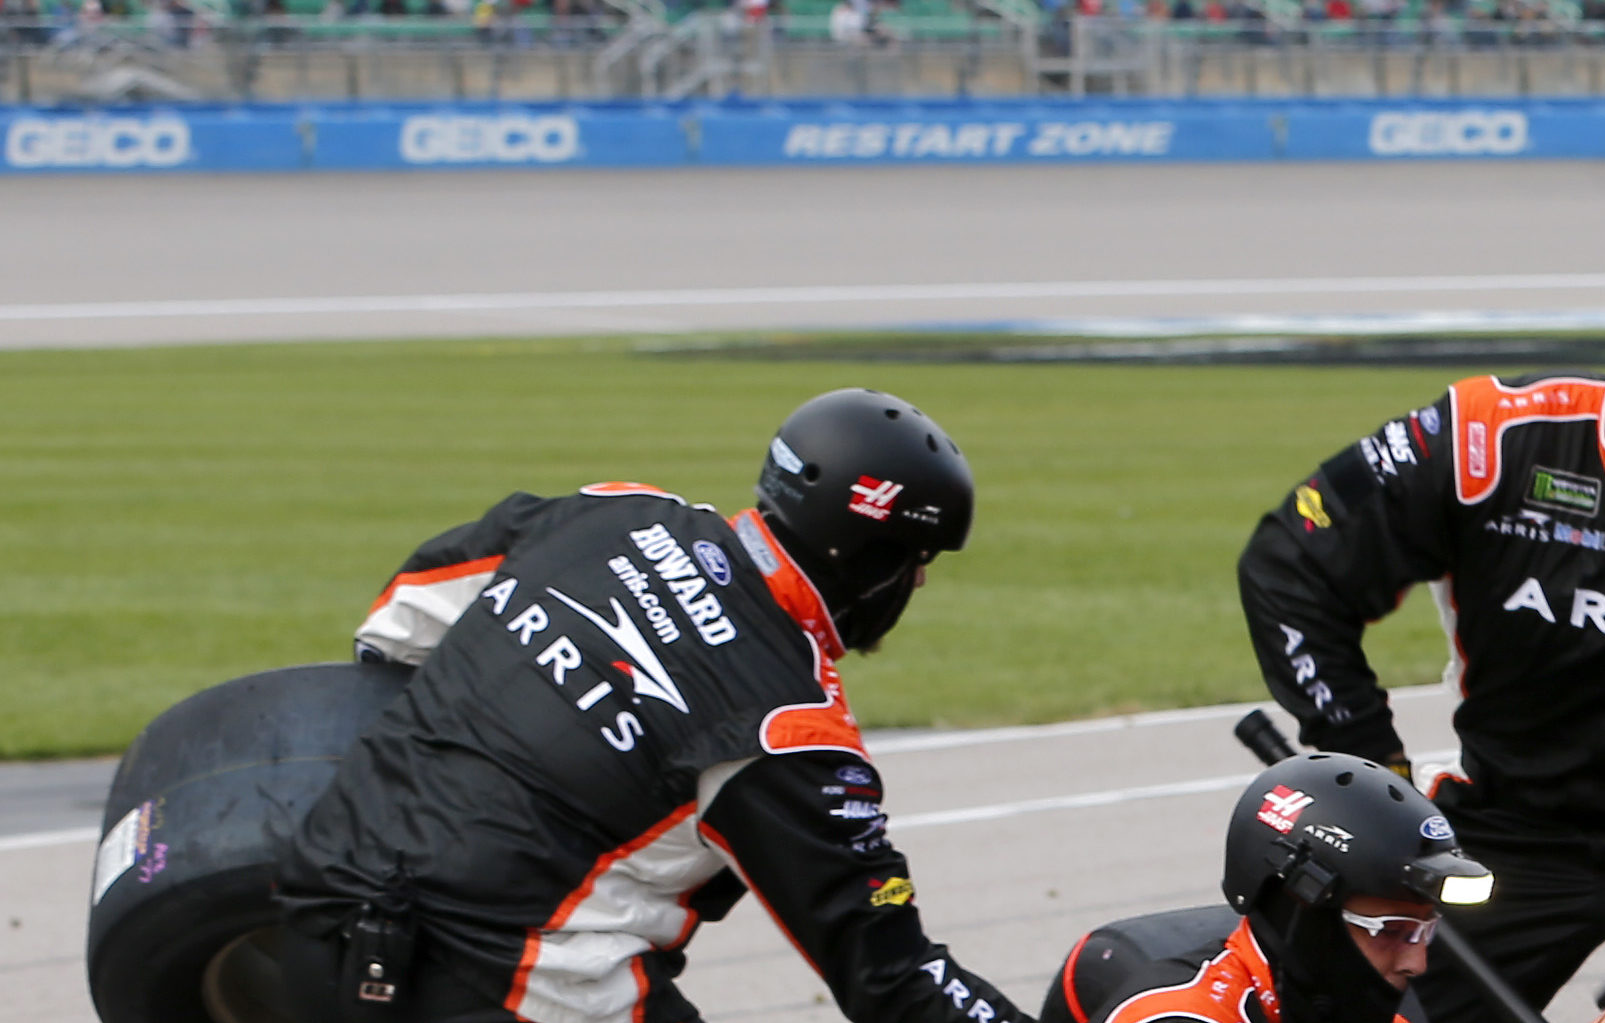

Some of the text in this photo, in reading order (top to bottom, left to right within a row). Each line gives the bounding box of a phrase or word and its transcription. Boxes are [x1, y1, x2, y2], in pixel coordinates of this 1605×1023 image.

[6, 118, 190, 167] GEICO
[401, 113, 578, 162] GEICO
[785, 121, 1174, 157] RESTART ZONE
[1369, 110, 1527, 155] GEICO
[606, 554, 683, 645] arris.com
[630, 522, 737, 647] HOWARD
[482, 576, 644, 753] ARRIS
[1303, 824, 1350, 853] ARRIS
